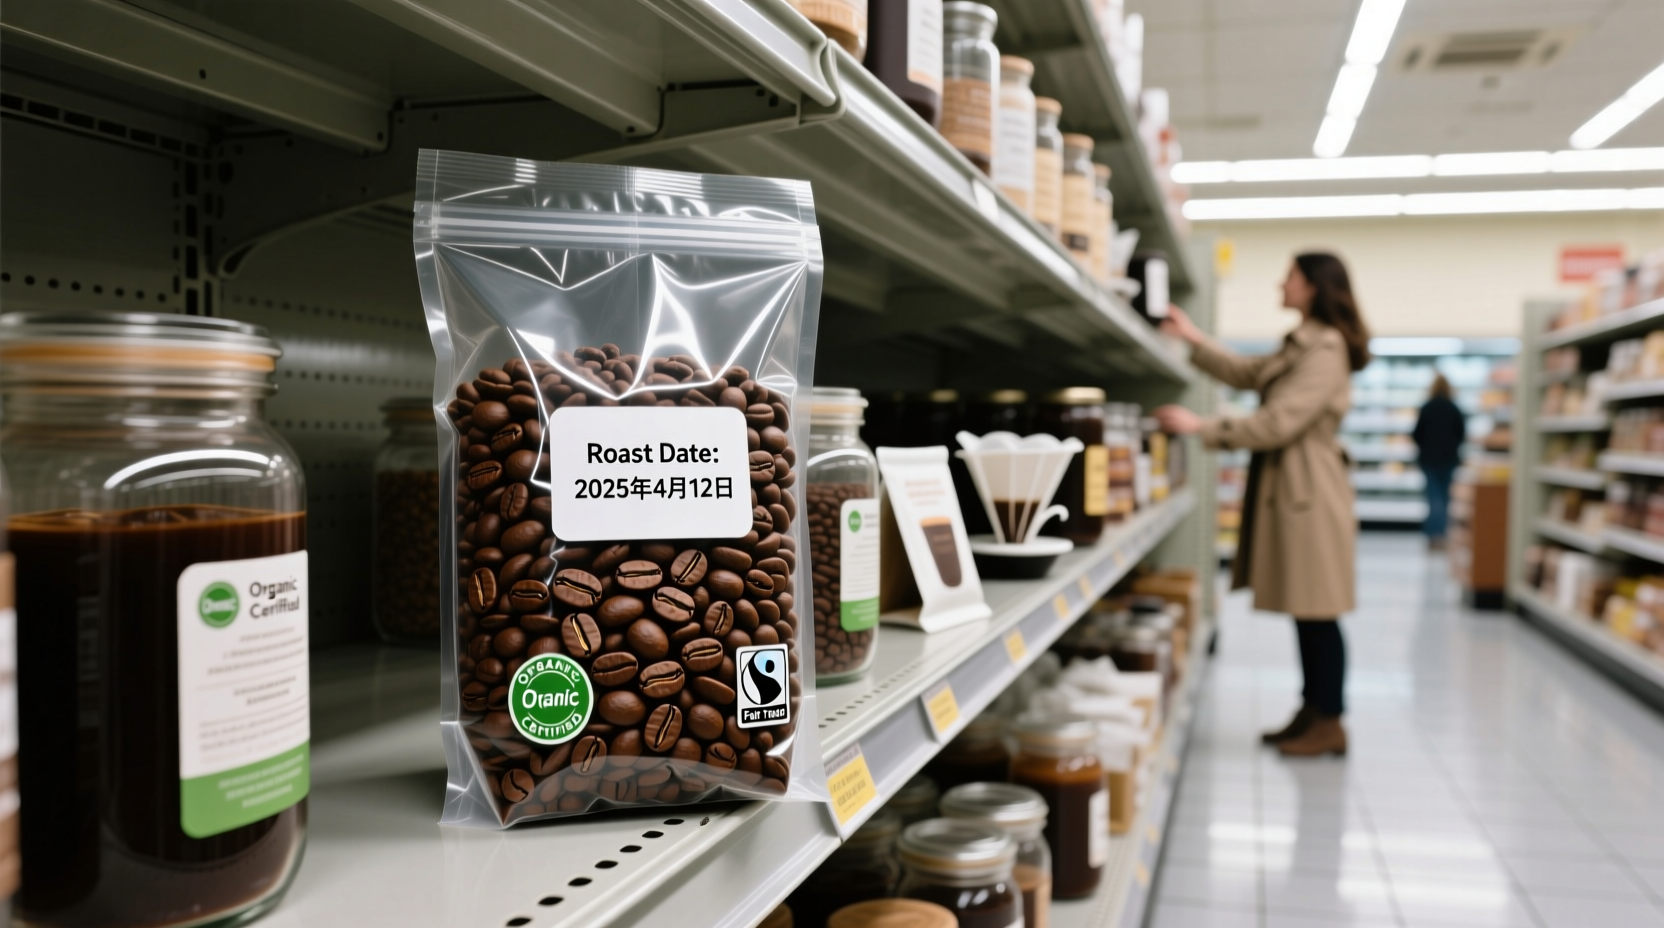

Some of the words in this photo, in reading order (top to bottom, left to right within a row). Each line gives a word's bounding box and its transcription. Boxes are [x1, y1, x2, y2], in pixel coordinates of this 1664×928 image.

[587, 442, 654, 464] Roast
[659, 442, 719, 464] Date:
[574, 476, 733, 500] 2025年4月12日
